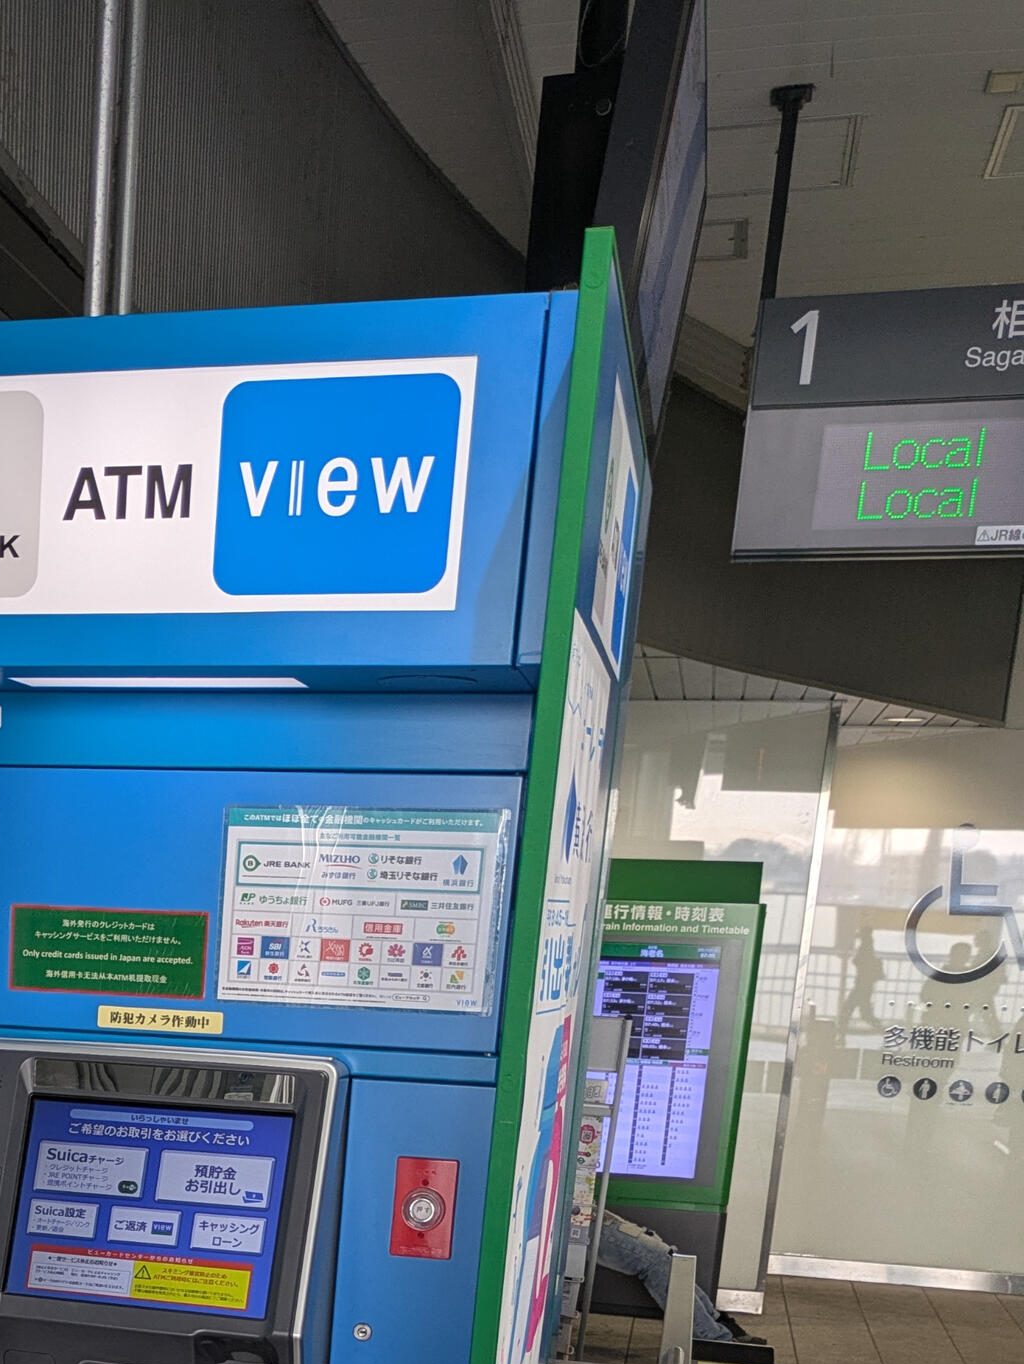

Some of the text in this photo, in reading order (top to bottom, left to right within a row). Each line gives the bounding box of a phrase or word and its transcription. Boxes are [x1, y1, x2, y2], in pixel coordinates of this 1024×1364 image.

[790, 310, 820, 385] 1
[864, 427, 987, 470] Local
[62, 463, 193, 521] ATM
[857, 477, 978, 520] Local
[990, 528, 1024, 542] JR線
[263, 860, 311, 869] JRE BANK
[319, 853, 361, 864] MIZUHO
[380, 855, 422, 866] りそな銀行
[379, 871, 438, 882] 埼玉りそな銀行
[442, 879, 474, 888] 横浜銀行
[259, 895, 307, 906] ゆうちょ銀行
[331, 899, 353, 907] MUFG
[431, 902, 474, 911] 三井住友銀行
[63, 919, 155, 930] 海外発行のクレジットカードは
[365, 923, 403, 934] 信用金庫
[602, 922, 750, 935] rain Information and Timetable
[23, 949, 40, 959] Only
[41, 950, 62, 959] credit
[64, 951, 83, 960] cards
[85, 952, 109, 961] issued
[110, 953, 117, 961] in
[119, 954, 141, 964] Japan
[157, 955, 193, 966] accepted.
[110, 1011, 210, 1029] 防犯カメラ作動中
[882, 1053, 955, 1070] Restroom
[131, 1114, 189, 1125] いらっしゃいませ
[69, 1123, 250, 1146] ご希望のお取引をお選びください
[46, 1148, 124, 1166] Suicaチャージ
[194, 1164, 237, 1180] 預貯金
[185, 1178, 241, 1196] お引出し
[34, 1205, 86, 1218] Suica設定
[113, 1219, 147, 1232] ご返済
[199, 1220, 260, 1235] キャッシング
[212, 1236, 243, 1248] ローン
